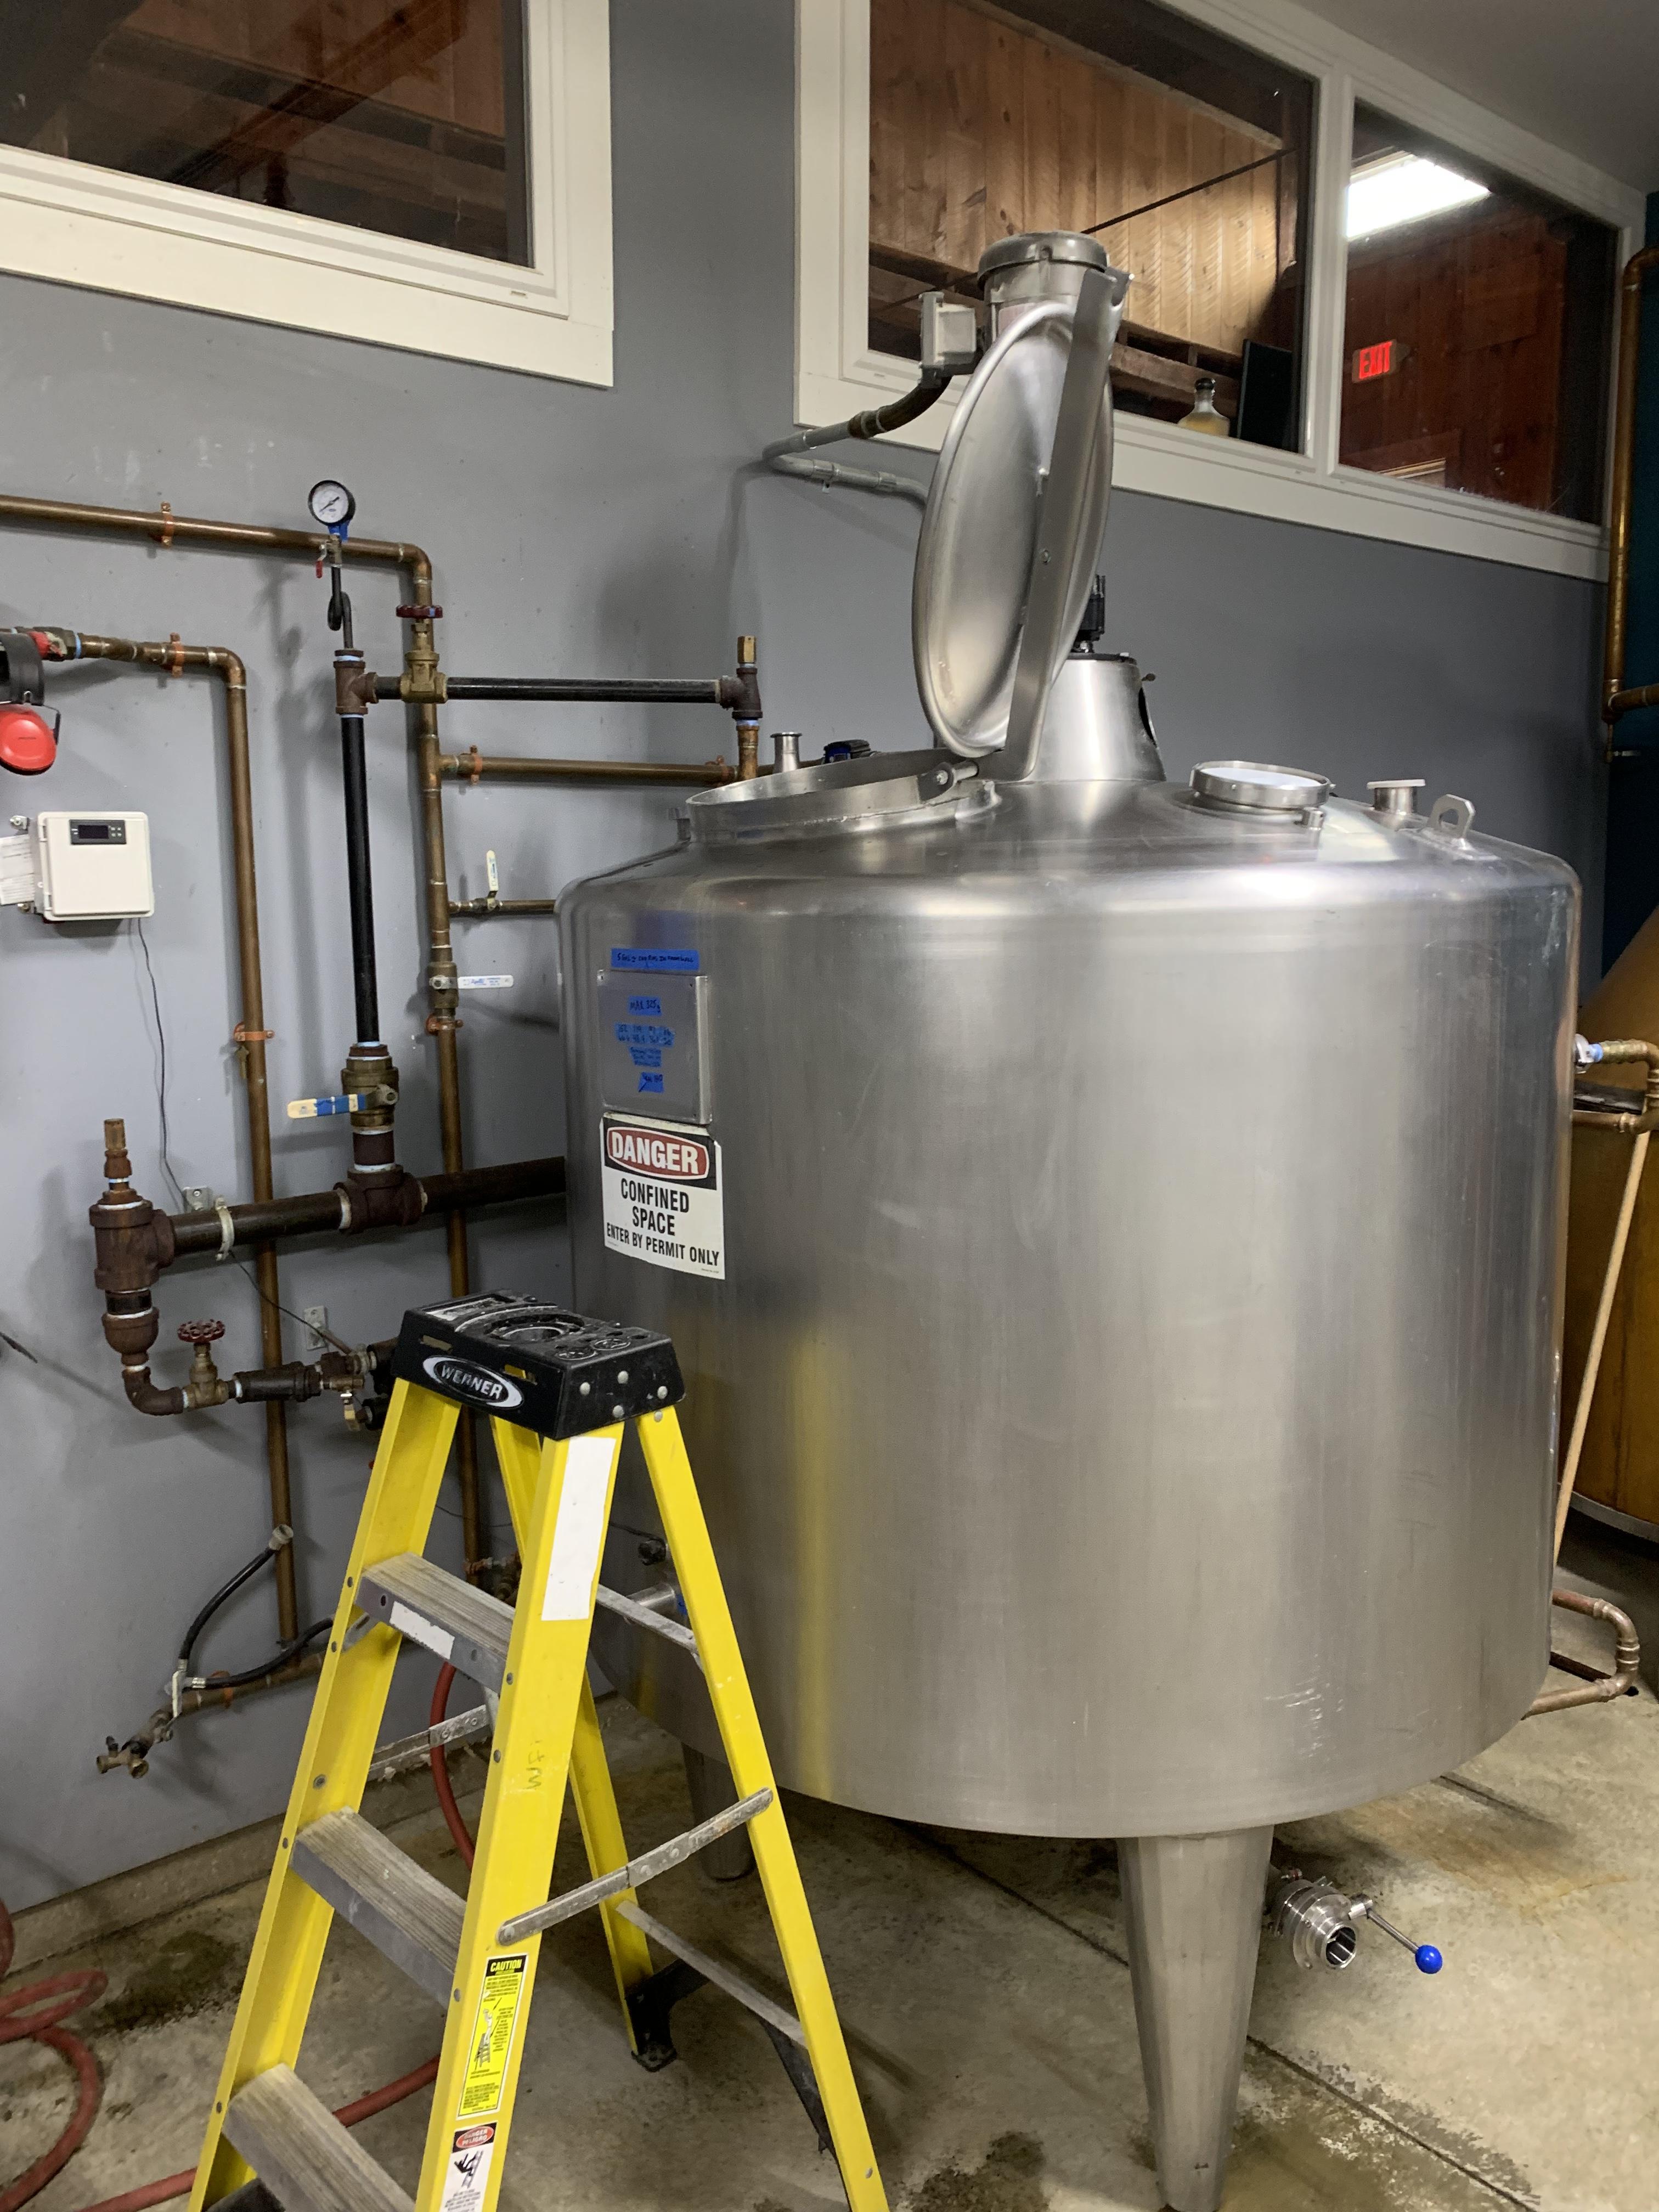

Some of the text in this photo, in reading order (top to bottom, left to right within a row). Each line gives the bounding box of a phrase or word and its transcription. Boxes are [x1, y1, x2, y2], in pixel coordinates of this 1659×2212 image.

[1360, 341, 1392, 379] EXIT
[612, 1131, 699, 1174] DANGER
[621, 1178, 689, 1212] CONFINED
[632, 1206, 675, 1236] SPACE
[607, 1222, 720, 1266] ENTER BY PERMIT ONLY
[441, 1365, 503, 1399] WERNER
[490, 1959, 522, 1972] CAUTION
